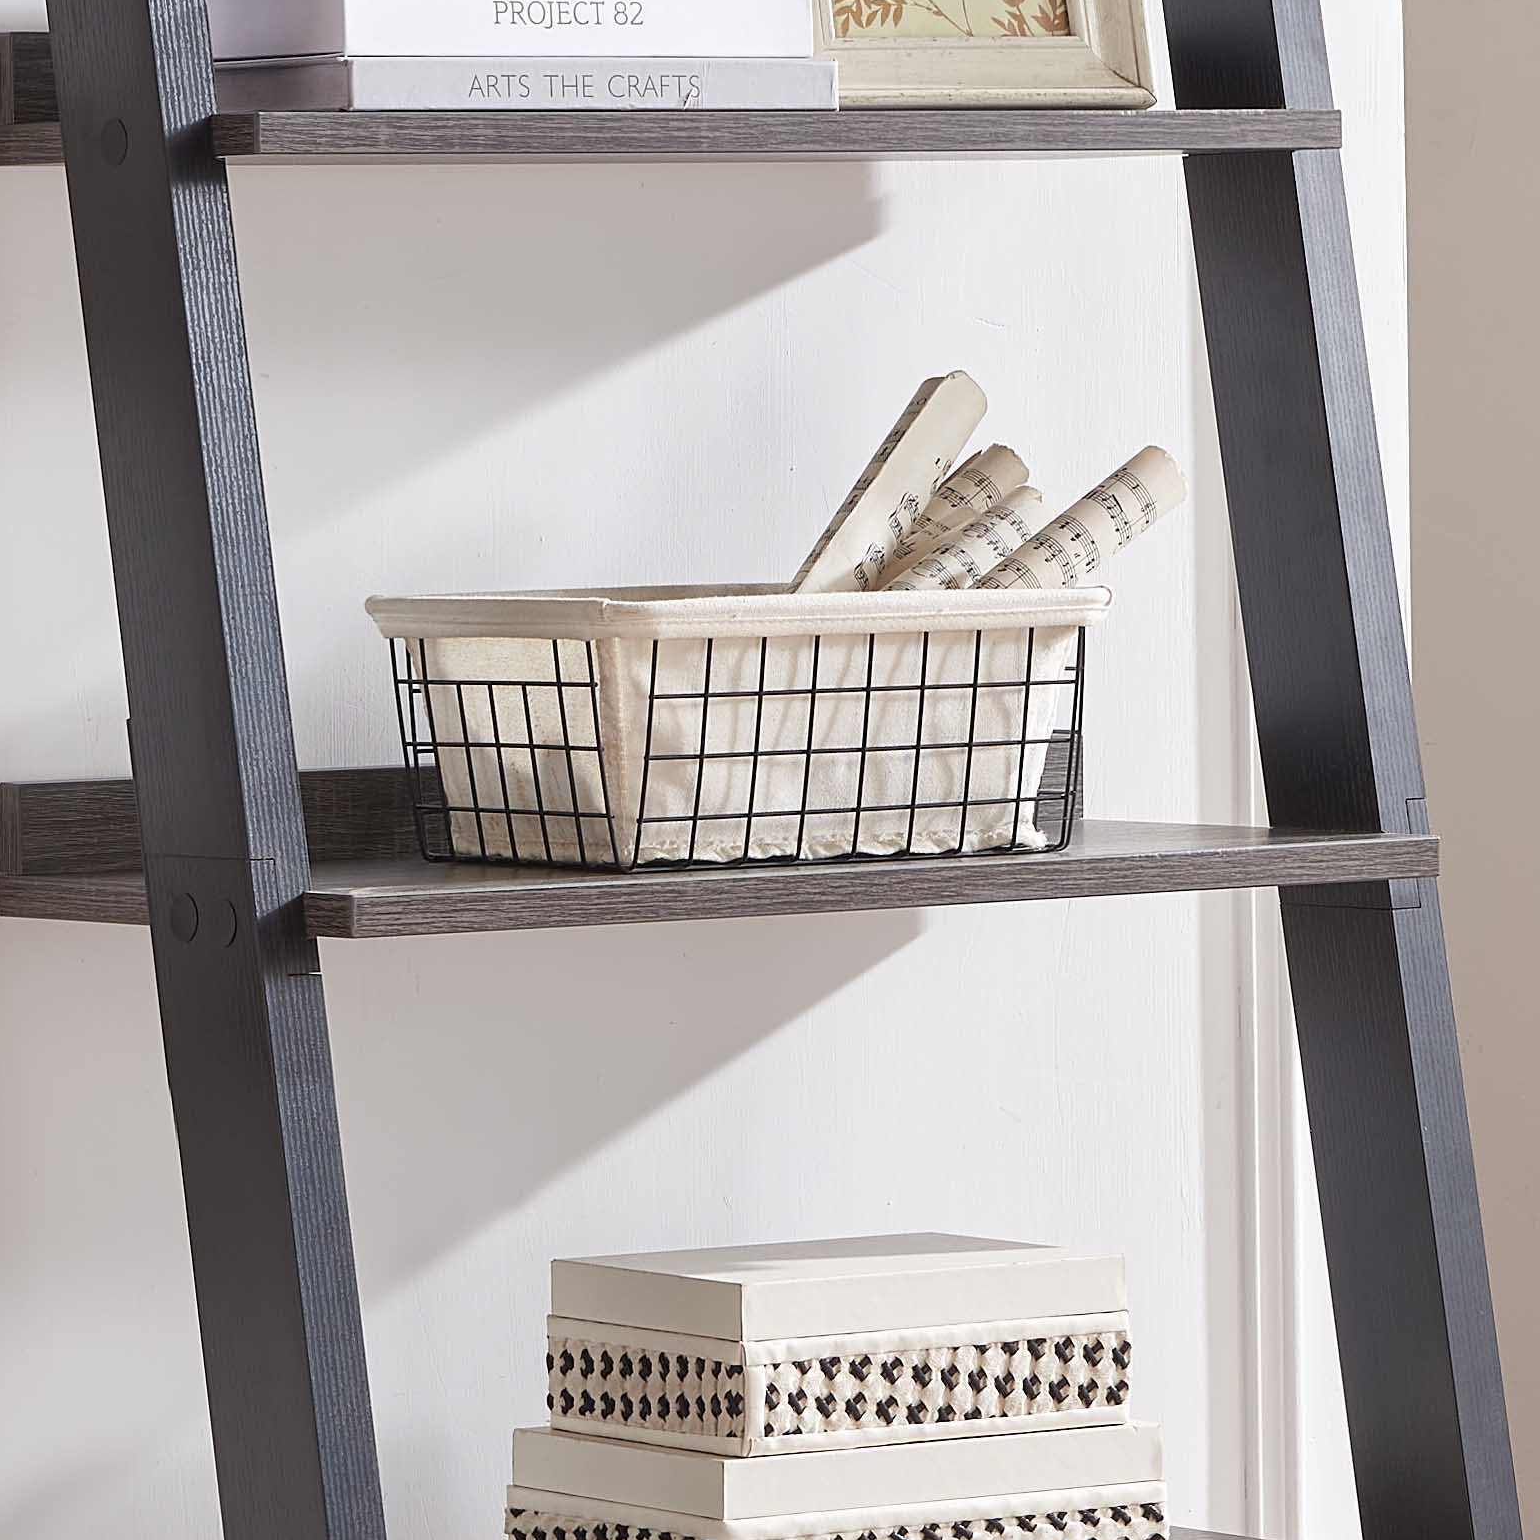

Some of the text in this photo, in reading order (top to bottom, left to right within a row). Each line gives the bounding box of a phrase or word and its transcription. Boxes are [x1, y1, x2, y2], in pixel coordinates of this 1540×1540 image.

[492, 0, 645, 30] PROJECT 82
[468, 74, 702, 100] ARTS THE CRAFTS
